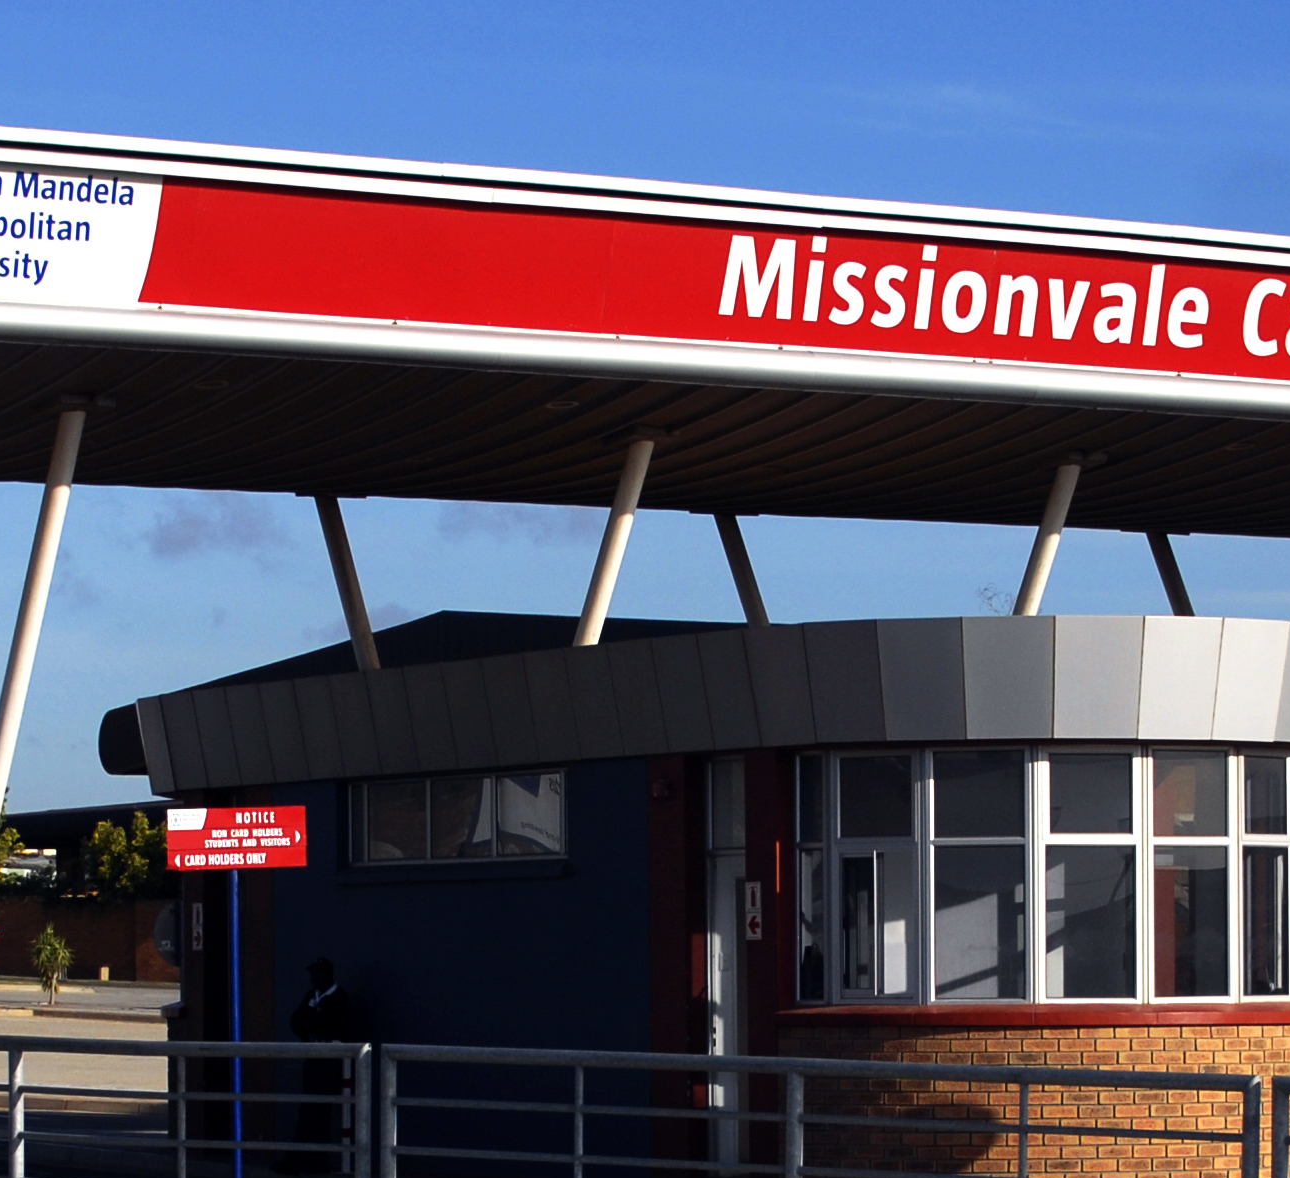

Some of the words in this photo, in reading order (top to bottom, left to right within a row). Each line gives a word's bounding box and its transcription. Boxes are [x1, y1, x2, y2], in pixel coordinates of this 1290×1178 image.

[12, 170, 135, 206] Mandela
[717, 234, 1211, 349] Missionvale
[235, 811, 275, 824] NOTICE
[211, 829, 228, 838] NON
[230, 828, 249, 838] CARD
[252, 827, 283, 837] HOLDERS
[204, 838, 239, 848] STUDENTS
[242, 838, 258, 847] AND
[260, 837, 291, 846] VISITORS
[184, 853, 206, 866] CARD
[208, 853, 245, 865] HOLDERS
[246, 852, 267, 864] ONLY
